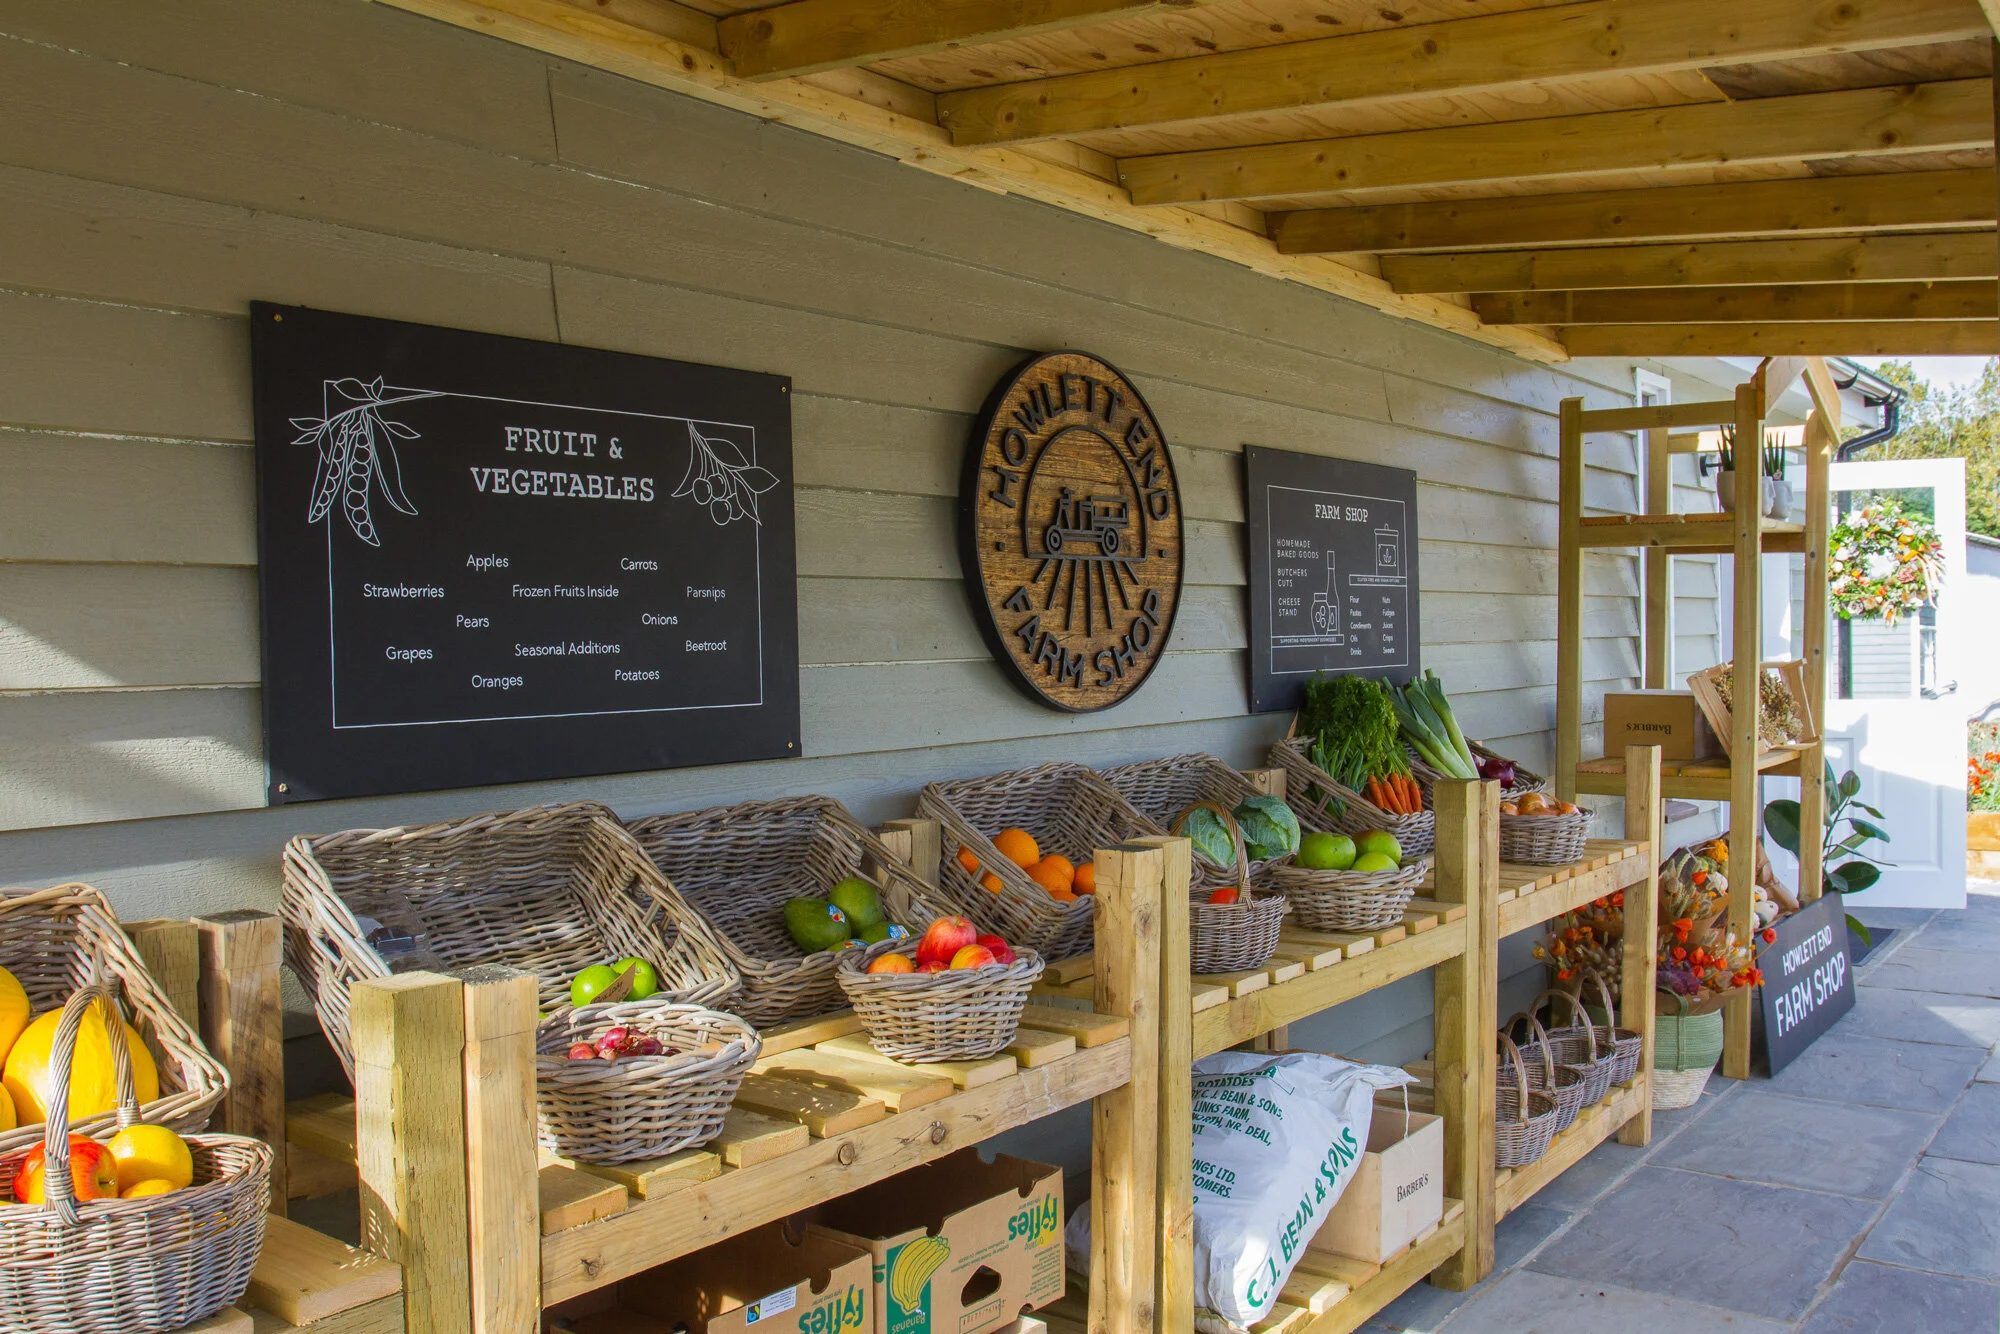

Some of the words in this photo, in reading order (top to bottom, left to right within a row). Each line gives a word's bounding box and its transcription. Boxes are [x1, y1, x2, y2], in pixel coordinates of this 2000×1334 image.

[504, 426, 597, 457] FRUIT
[609, 437, 623, 460] &
[990, 373, 1123, 508] HOWLETT
[1125, 417, 1171, 521] END
[469, 466, 655, 502] VEGETABLES
[1314, 503, 1341, 520] FARM
[1345, 506, 1369, 523] SHOP
[1276, 538, 1311, 549] HOMEMADE
[466, 553, 509, 572] Apples
[1277, 549, 1297, 559] BAKED
[1298, 550, 1319, 559] GOODS
[620, 557, 658, 571] Carrots
[1277, 567, 1308, 577] BUTCHERS
[363, 582, 445, 599] Strawberries
[512, 584, 552, 598] Frozen
[554, 584, 586, 598] Fruits
[587, 584, 620, 598] Inside
[1277, 578, 1293, 588] CUTS
[686, 585, 726, 602] Parsnips
[1278, 597, 1301, 606] CHEESE
[641, 612, 678, 626] Onions
[1278, 608, 1298, 617] STAND
[456, 614, 490, 629] Pears
[685, 639, 727, 652] Beetroot
[1003, 586, 1085, 689] FARM
[1097, 589, 1161, 687] SHOP
[385, 646, 433, 664] Grapes
[514, 641, 566, 657] Seasonal
[567, 640, 621, 655] Additions
[471, 674, 524, 690] Oranges
[614, 669, 660, 681] Potatoes
[1782, 934, 1818, 976] HOWLETT
[1818, 925, 1832, 951] END
[1775, 977, 1814, 1037] FARM
[1814, 951, 1845, 1006] SHOP
[1220, 1090, 1247, 1104] BEAN
[1248, 1094, 1255, 1106] &
[1193, 1100, 1222, 1113] LINKS
[1221, 1105, 1251, 1122] FARM,
[1225, 1119, 1242, 1132] NR.
[1245, 1125, 1272, 1147] DEAL,
[1215, 1167, 1236, 1185] LTD.
[1246, 1278, 1268, 1308] C.
[1268, 1256, 1281, 1290] J.
[1280, 1192, 1314, 1263] BEAN
[1314, 1177, 1326, 1204] &
[1320, 1127, 1358, 1188] SONS
[892, 1314, 926, 1334] Bananas
